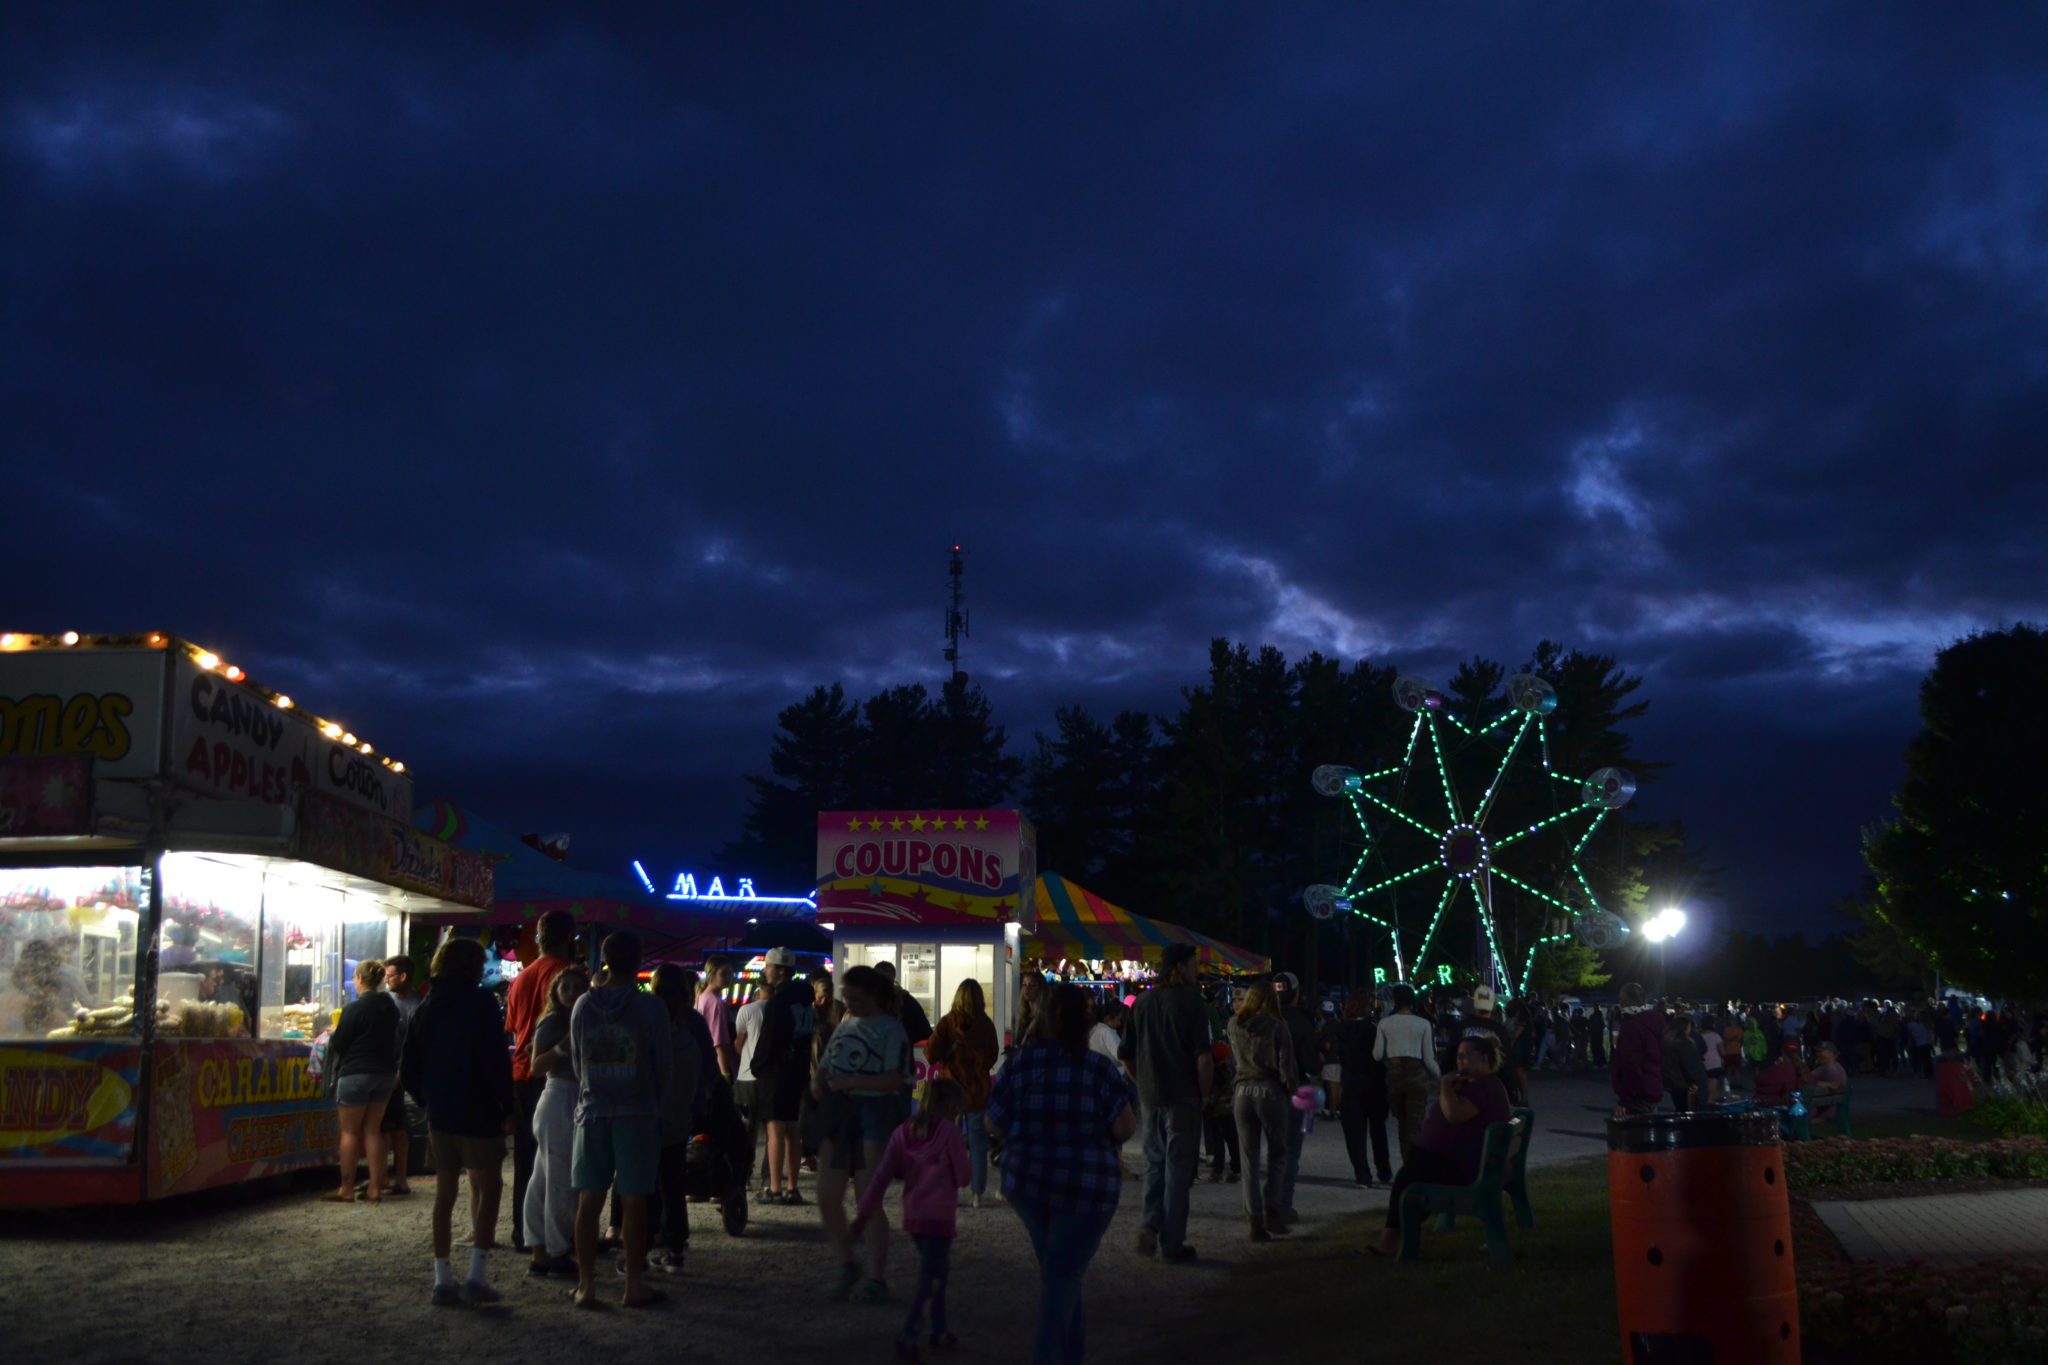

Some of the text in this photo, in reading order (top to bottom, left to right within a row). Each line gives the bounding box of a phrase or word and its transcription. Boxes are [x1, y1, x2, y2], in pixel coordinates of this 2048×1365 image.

[191, 674, 283, 751] CANDY
[187, 735, 286, 804] APPLES
[328, 745, 387, 810] Cotton
[834, 839, 1002, 889] COUPONS
[0, 1065, 100, 1131] NDY
